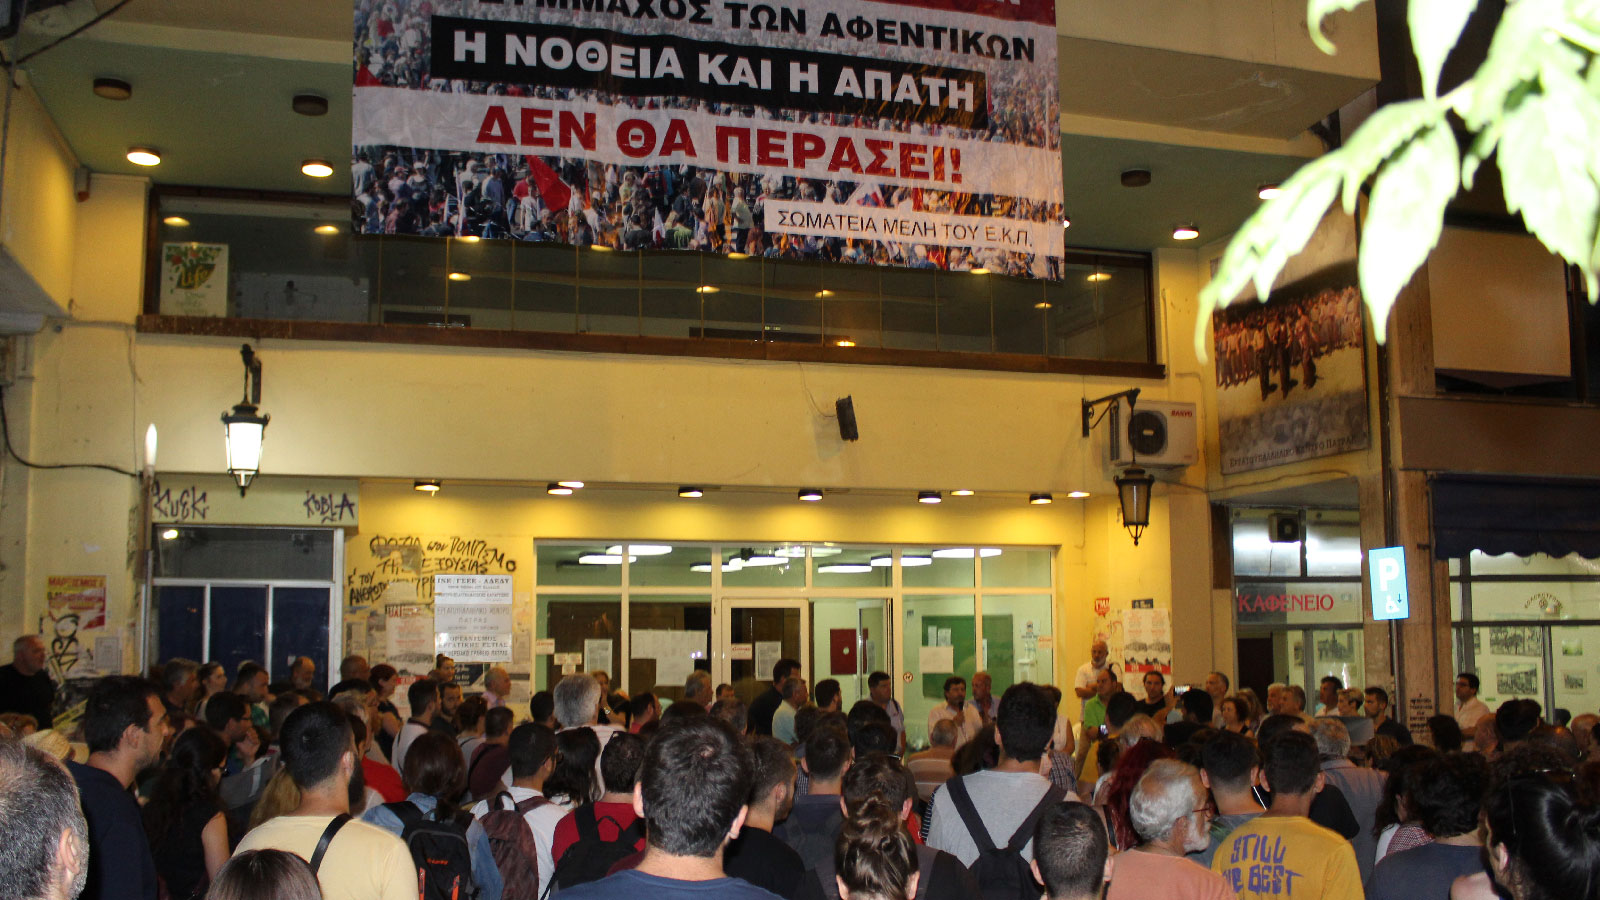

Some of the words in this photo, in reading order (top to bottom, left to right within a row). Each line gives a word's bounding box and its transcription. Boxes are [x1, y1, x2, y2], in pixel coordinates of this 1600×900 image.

[478, 0, 713, 25] ΑΧΟΣ
[724, 3, 807, 34] ΤΩΝ
[820, 12, 1035, 63] ΑΦΕΝΤΙΚΩΝ
[454, 30, 486, 63] Η
[505, 34, 684, 80] ΝΟΘΕΙΑ
[698, 52, 772, 90] ΚΑΙ
[789, 61, 819, 94] Η
[834, 66, 975, 113] ΑΠΑΤΗ
[475, 105, 597, 151] ΔΕΝ
[616, 118, 698, 158] ΘΑ
[715, 125, 963, 184] ΠΕΡΑΣΕΙ!
[777, 209, 878, 234] ΣΩΜΑΤΕΙΑ
[883, 219, 936, 238] ΜΕΛΗ
[941, 224, 979, 241] ΤΟΥ
[985, 226, 1033, 248] Ε.Κ.Π.
[1378, 557, 1400, 591] P
[1238, 594, 1334, 613] ΚΑΦΕΝΕΙΟ
[1231, 834, 1287, 864] STILL
[1248, 864, 1304, 896] BEST
